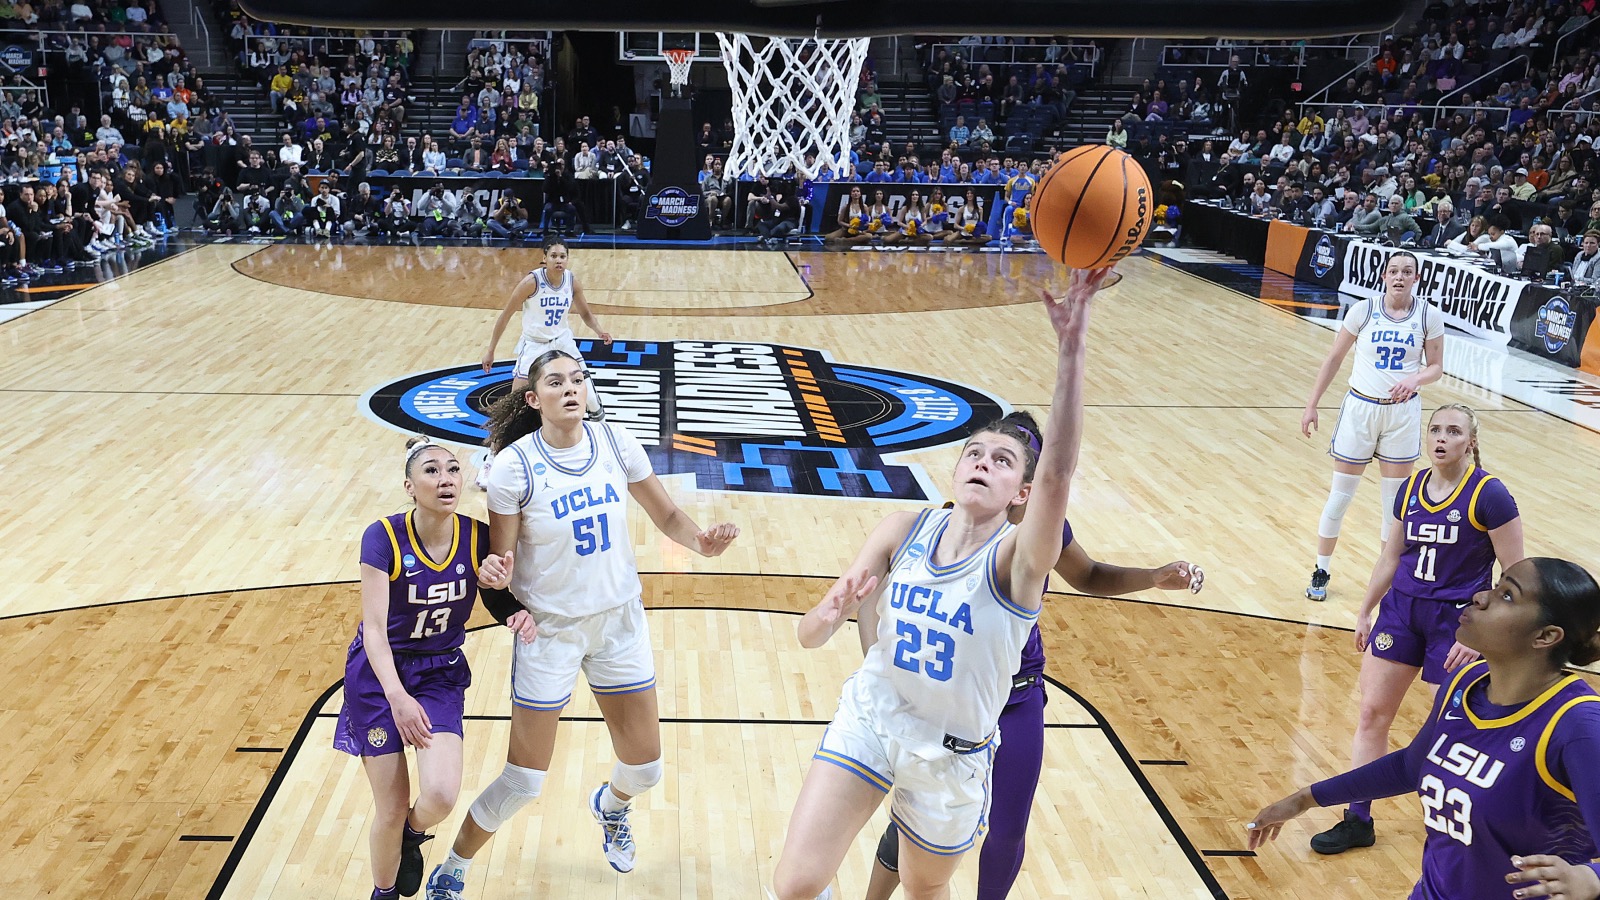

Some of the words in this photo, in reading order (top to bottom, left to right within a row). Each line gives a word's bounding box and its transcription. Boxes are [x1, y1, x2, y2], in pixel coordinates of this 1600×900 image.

[658, 197, 686, 206] MARCH
[661, 205, 697, 214] MADNESS
[1106, 187, 1147, 263] Wilson
[540, 297, 569, 307] UCLA
[1416, 260, 1510, 334] REGIONAL
[545, 309, 565, 326] 35
[1546, 309, 1568, 326] MARCH
[1547, 321, 1572, 340] MADNESS
[1371, 330, 1416, 347] UCLA
[1374, 346, 1407, 370] 32
[673, 342, 807, 437] MADNESS
[413, 390, 471, 419] SWEET
[909, 396, 959, 421] ELITE
[551, 483, 620, 520] UCLA
[572, 513, 612, 557] 51
[1407, 521, 1459, 544] LSU
[1413, 545, 1437, 582] 11
[408, 579, 467, 605] LSU
[409, 607, 452, 639] 13
[890, 582, 974, 635] UCLA
[893, 619, 956, 682] 23
[1426, 733, 1505, 789] LSU
[1420, 774, 1473, 846] 23
